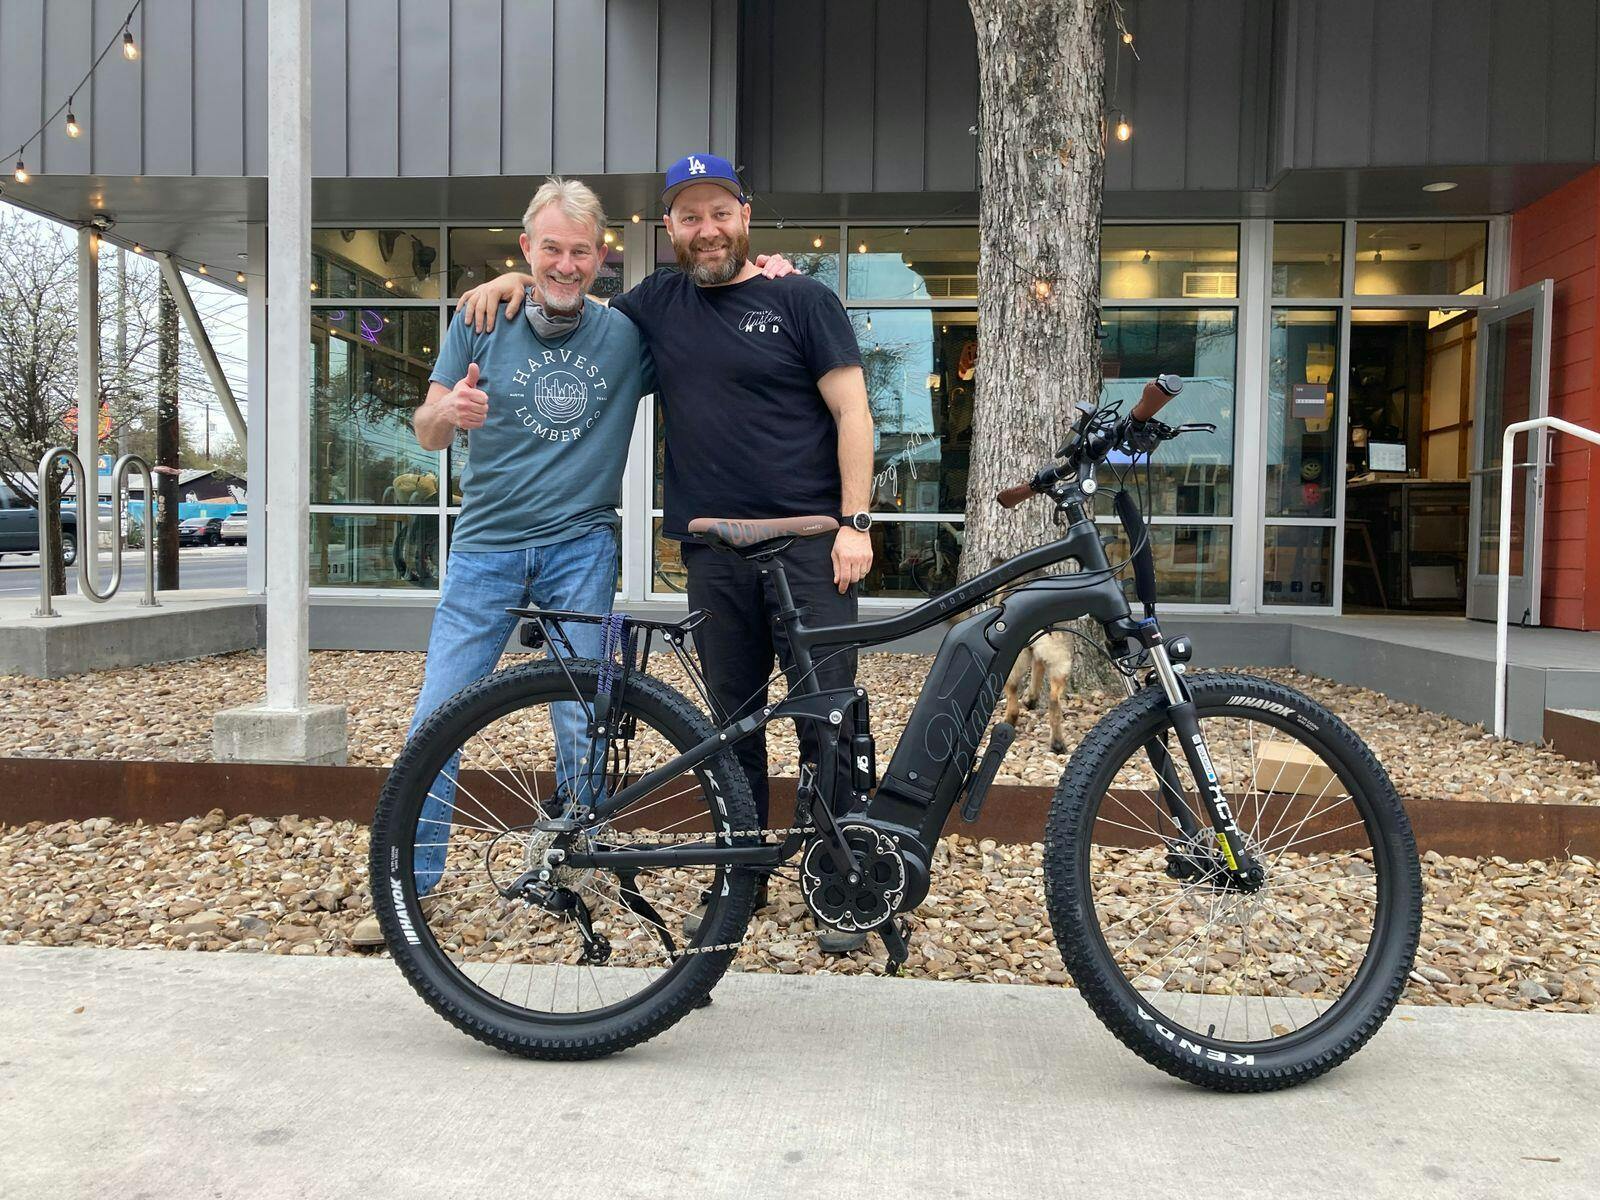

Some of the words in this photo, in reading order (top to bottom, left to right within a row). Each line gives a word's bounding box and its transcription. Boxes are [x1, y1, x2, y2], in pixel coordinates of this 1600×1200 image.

[687, 155, 706, 175] LA
[744, 324, 780, 334] MOD
[512, 348, 607, 390] HARVEST
[515, 406, 581, 442] LUMBER
[1242, 697, 1296, 718] HAVOK
[1209, 784, 1240, 836] XCT
[390, 876, 416, 934] HAVOK
[1137, 1003, 1255, 1066] KENDA
